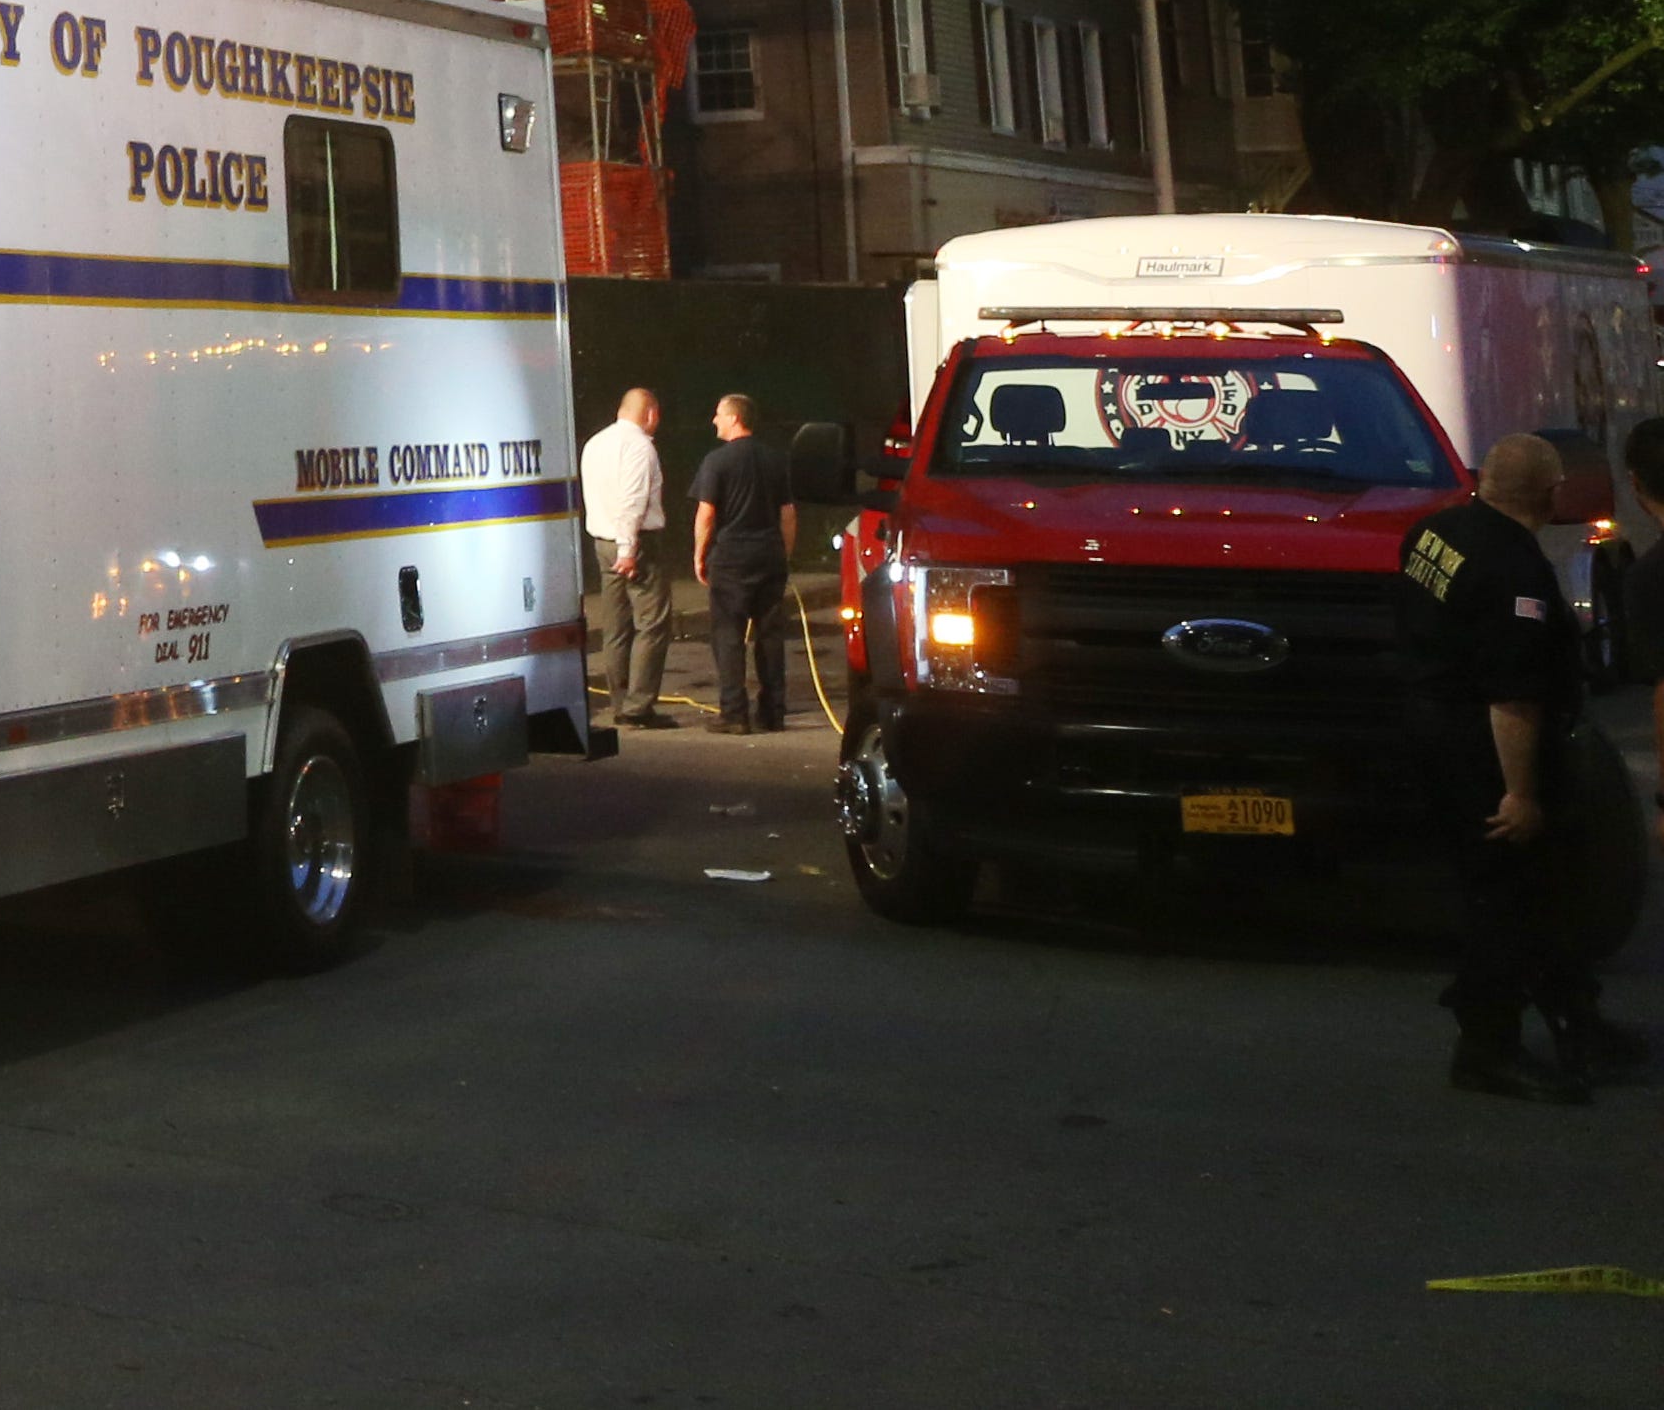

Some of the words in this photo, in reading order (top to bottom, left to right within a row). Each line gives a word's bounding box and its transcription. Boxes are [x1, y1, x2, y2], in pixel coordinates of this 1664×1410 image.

[51, 10, 107, 77] OF
[135, 26, 416, 124] POUGHKEEPSIE
[127, 140, 269, 212] POLICE
[296, 446, 379, 491] MOBILE
[389, 441, 490, 482] COMMAND
[498, 439, 543, 477] UNIT
[138, 612, 160, 634] FOR
[167, 603, 230, 631] EMERGENCY
[155, 639, 179, 663] DIAL
[187, 631, 210, 664] 911
[1241, 799, 1285, 825] 1090
